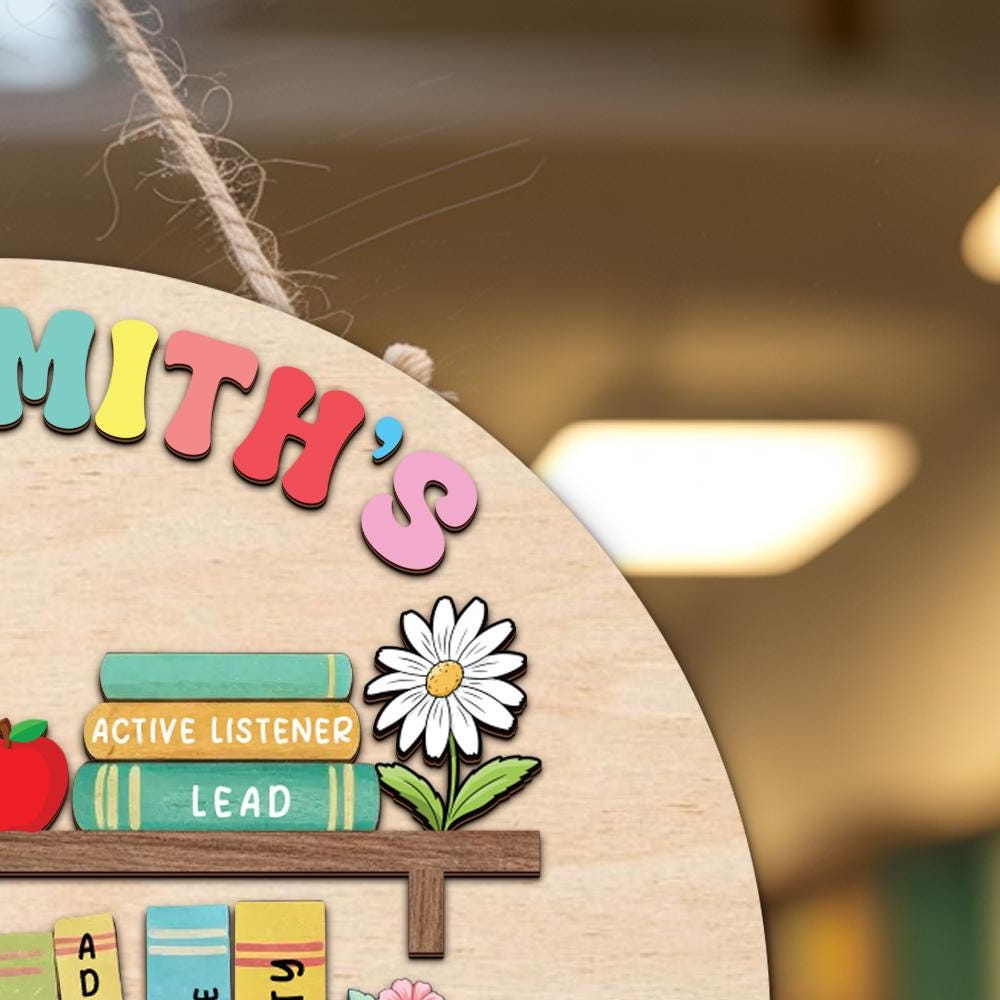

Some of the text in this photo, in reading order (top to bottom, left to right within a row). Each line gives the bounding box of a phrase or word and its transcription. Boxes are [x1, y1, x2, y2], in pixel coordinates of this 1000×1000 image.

[91, 716, 354, 745] ACTIVE LISTENER
[191, 784, 292, 818] LEAD
